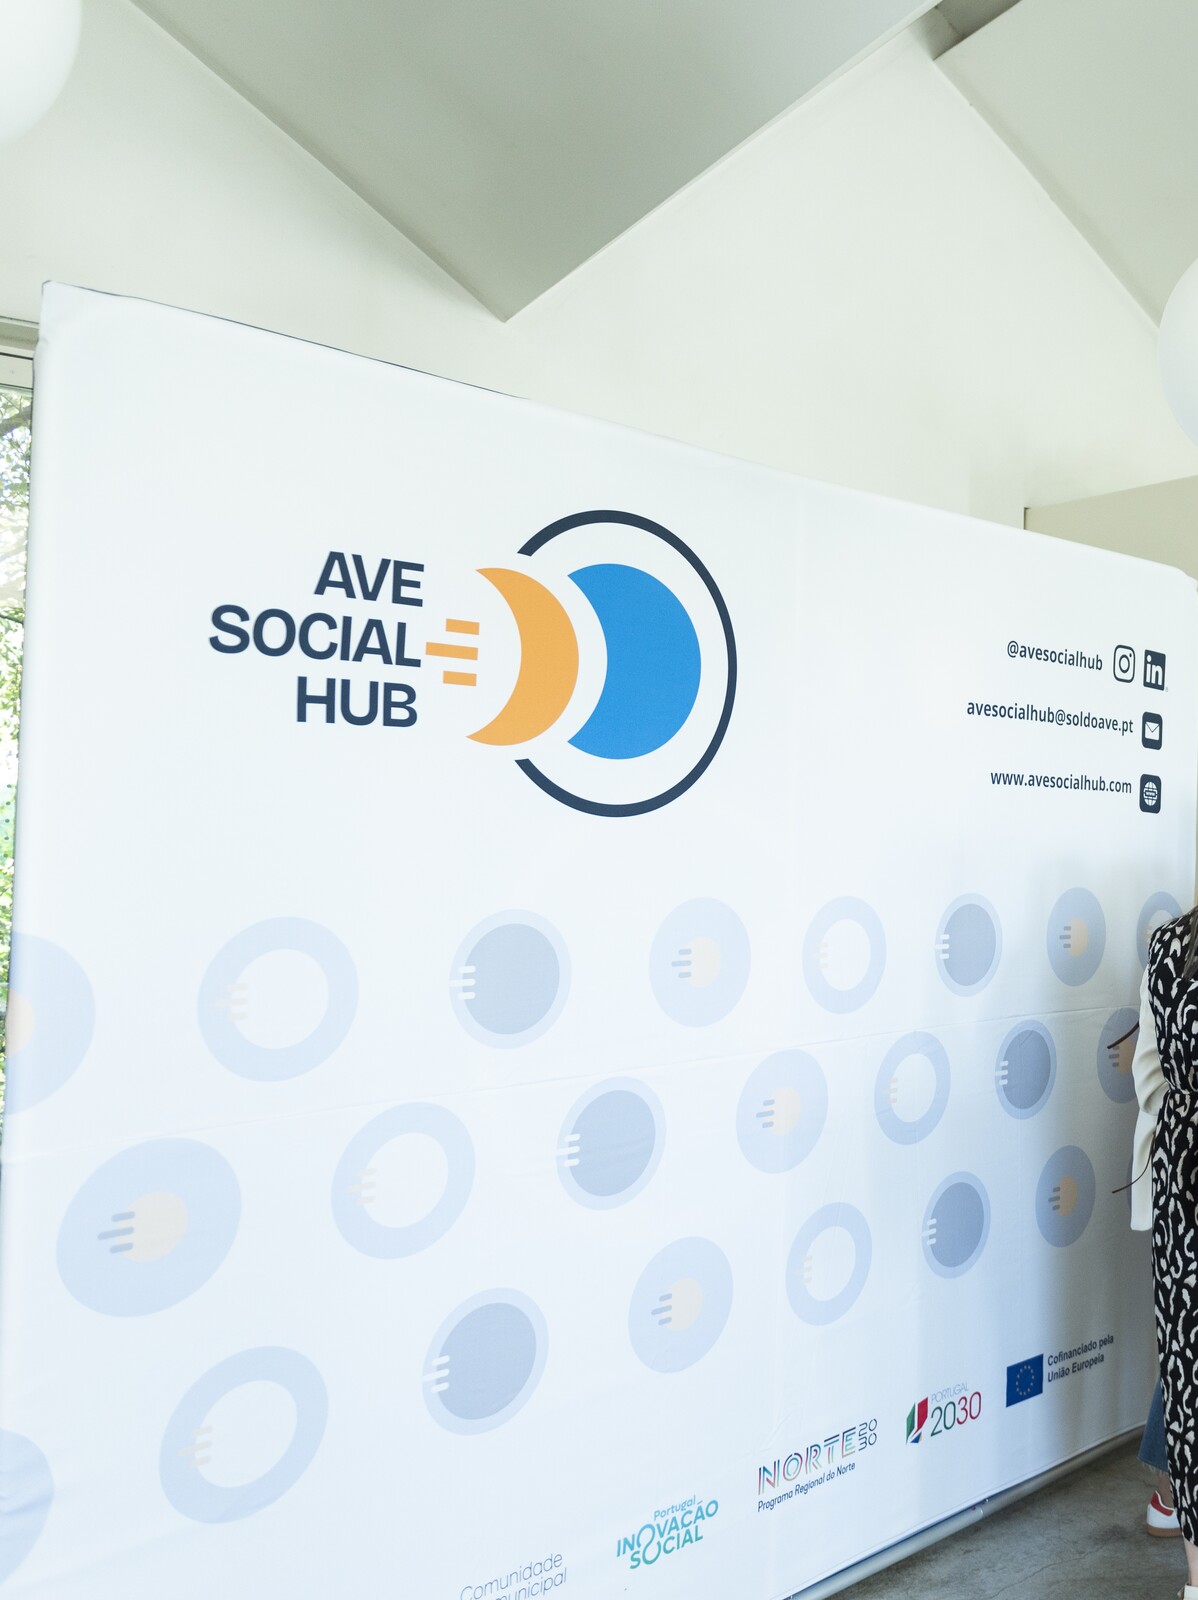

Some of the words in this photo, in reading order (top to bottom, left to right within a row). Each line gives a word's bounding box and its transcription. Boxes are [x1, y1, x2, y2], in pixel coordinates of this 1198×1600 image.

[314, 551, 424, 607] AVE
[209, 604, 421, 667] SOCIAL
[1007, 640, 1103, 671] @avesocialhub
[297, 676, 417, 727] HUB
[967, 701, 1133, 736] avesocialhub@soldoave.pt
[990, 772, 1132, 794] www.avesocialhub.com
[1047, 1340, 1097, 1366] Cofinanciado
[1099, 1334, 1114, 1349] pela
[1047, 1367, 1070, 1382] União
[1072, 1353, 1104, 1373] Europeia
[931, 1381, 968, 1404] PORTUGAL
[858, 1418, 878, 1437] 20
[930, 1391, 981, 1437] 2030
[858, 1432, 877, 1451] 30
[758, 1426, 857, 1496] NORTE
[758, 1490, 794, 1512] Programa
[795, 1472, 825, 1494] Regional
[826, 1470, 835, 1481] do
[836, 1462, 856, 1476] Norte
[654, 1494, 696, 1521] Portugal
[630, 1525, 704, 1569] SOCIAL
[460, 1553, 562, 1600] Comunidade
